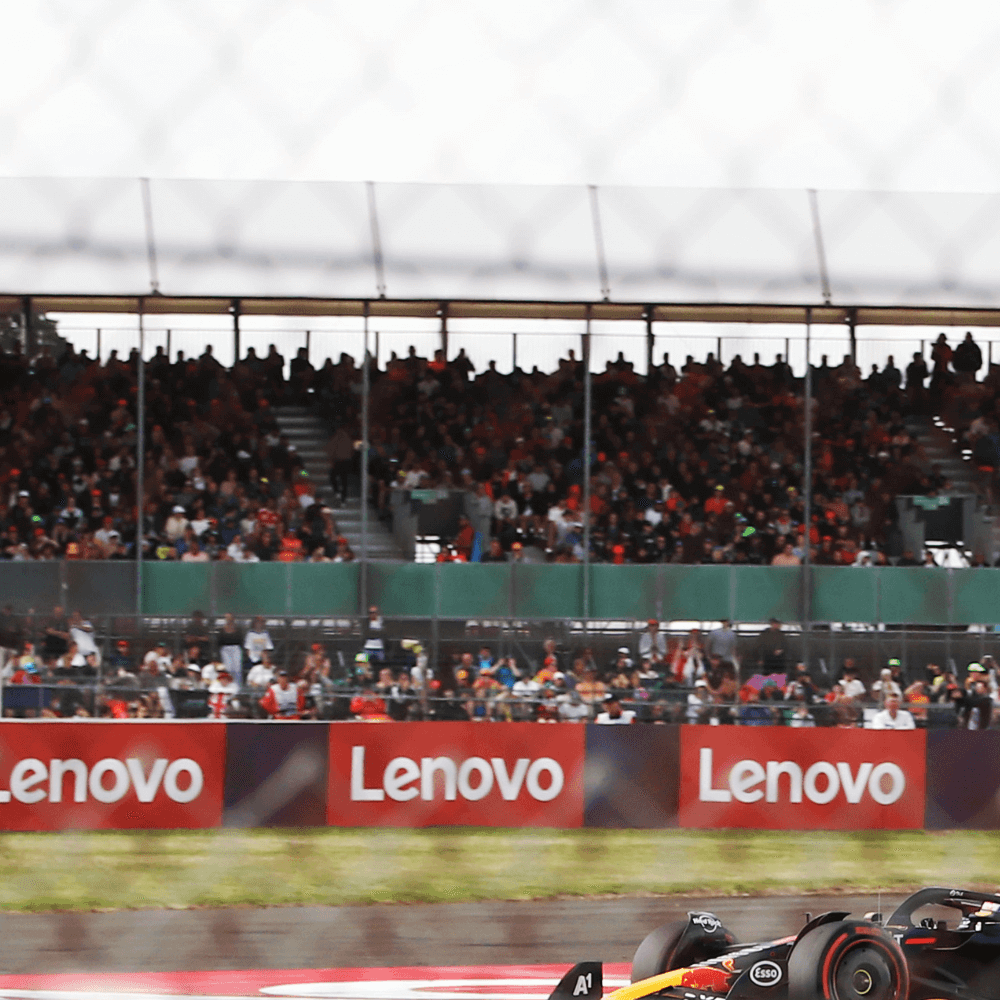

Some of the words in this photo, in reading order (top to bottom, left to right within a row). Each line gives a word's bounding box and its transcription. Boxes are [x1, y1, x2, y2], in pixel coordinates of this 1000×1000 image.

[0, 758, 203, 804] enovo
[351, 745, 564, 801] Lenovo
[700, 747, 905, 804] Lenovo
